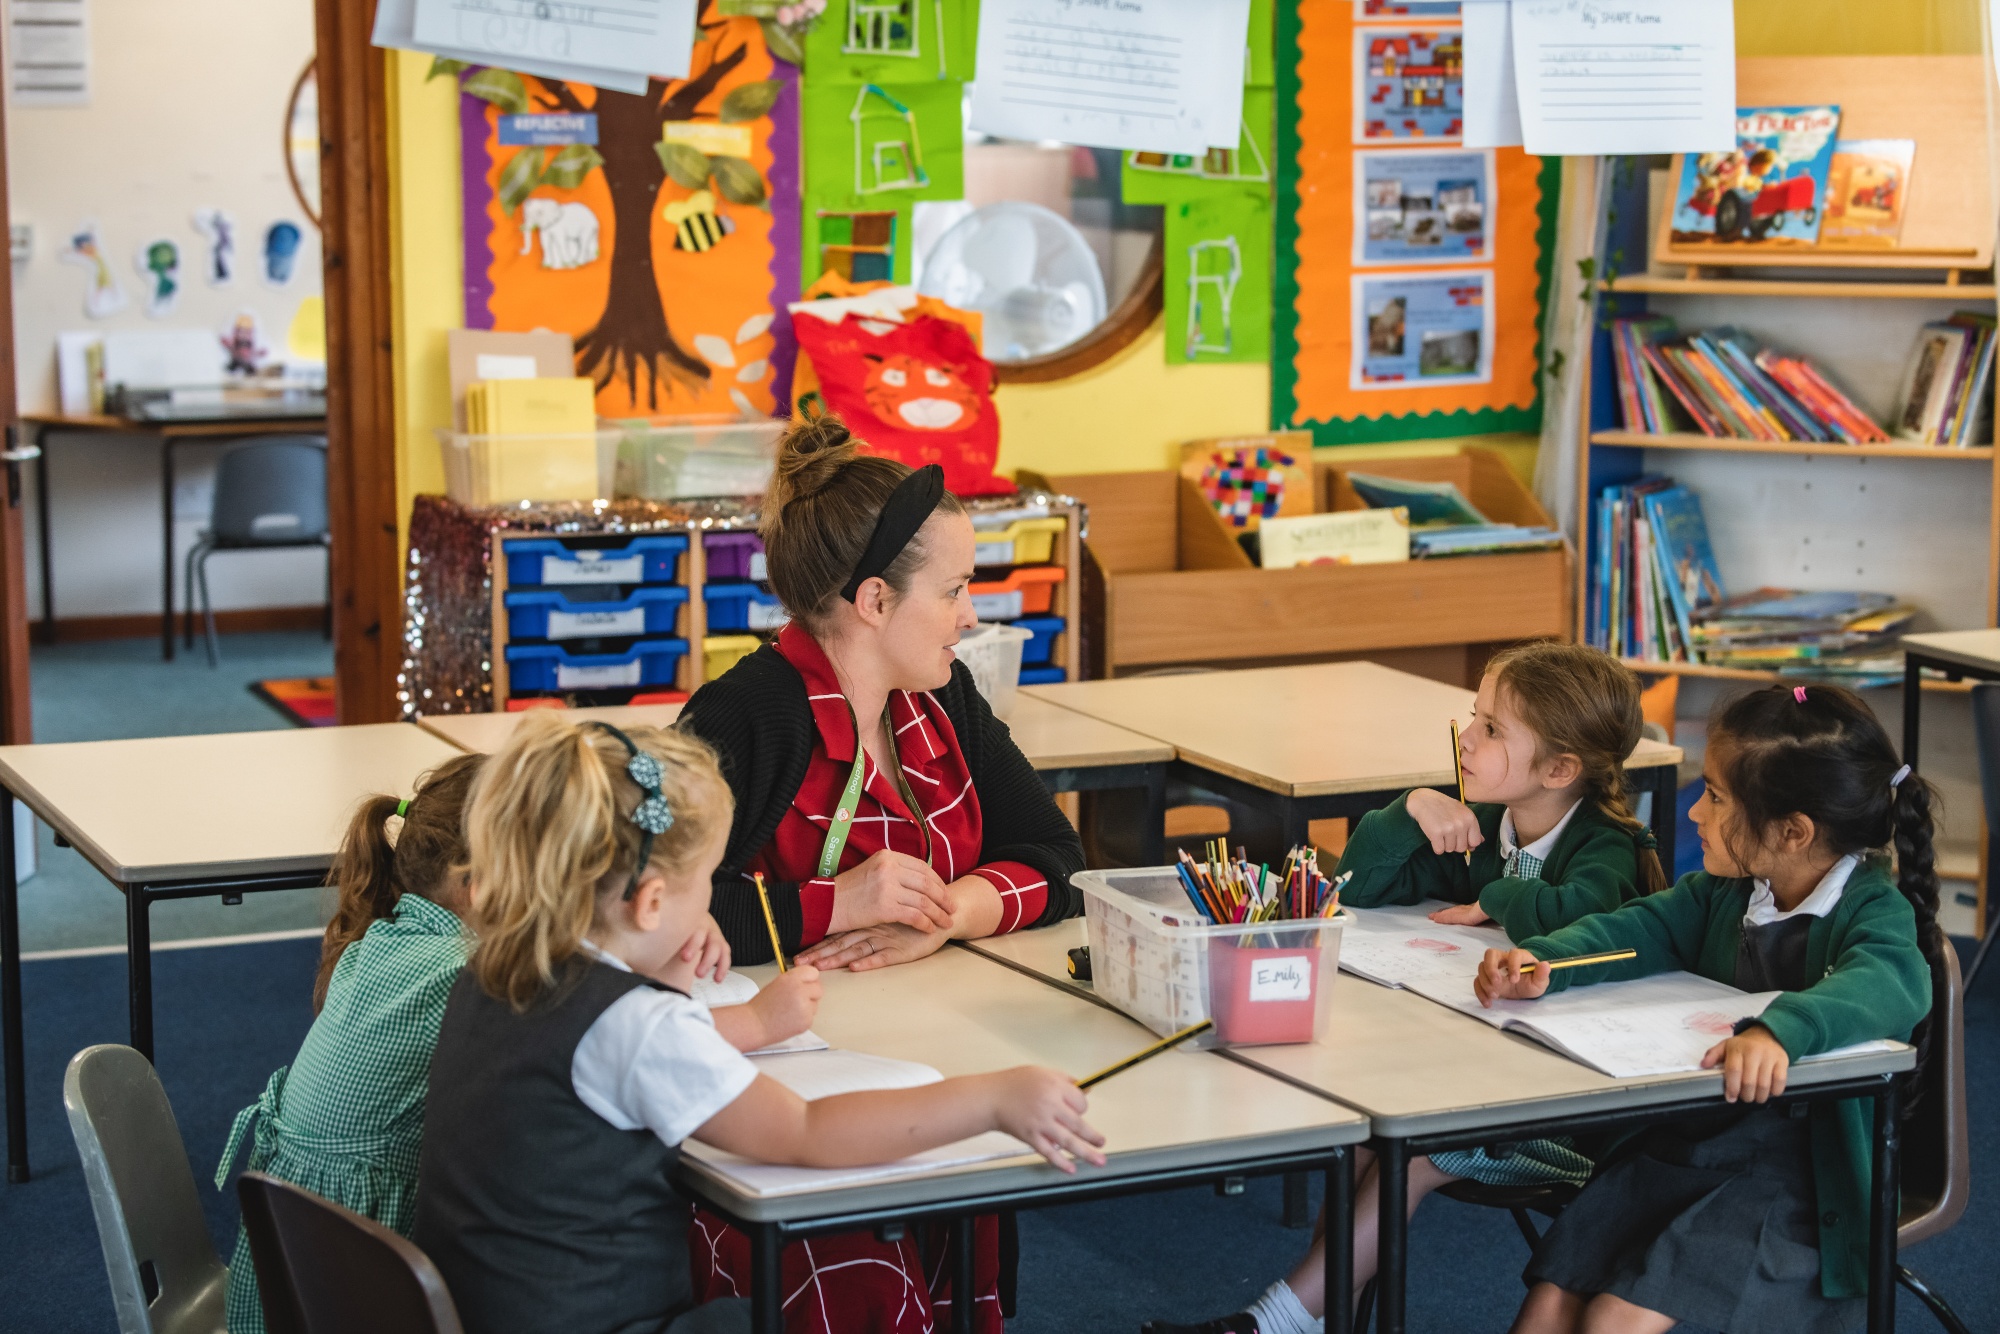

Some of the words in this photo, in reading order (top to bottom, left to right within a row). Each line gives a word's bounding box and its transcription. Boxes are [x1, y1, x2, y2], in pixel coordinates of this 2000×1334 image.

[1582, 12, 1597, 29] My
[1601, 12, 1632, 24] SHAPE
[1635, 13, 1661, 24] home
[849, 762, 863, 794] School
[824, 836, 840, 866] Saxon
[1257, 964, 1303, 990] Emily
